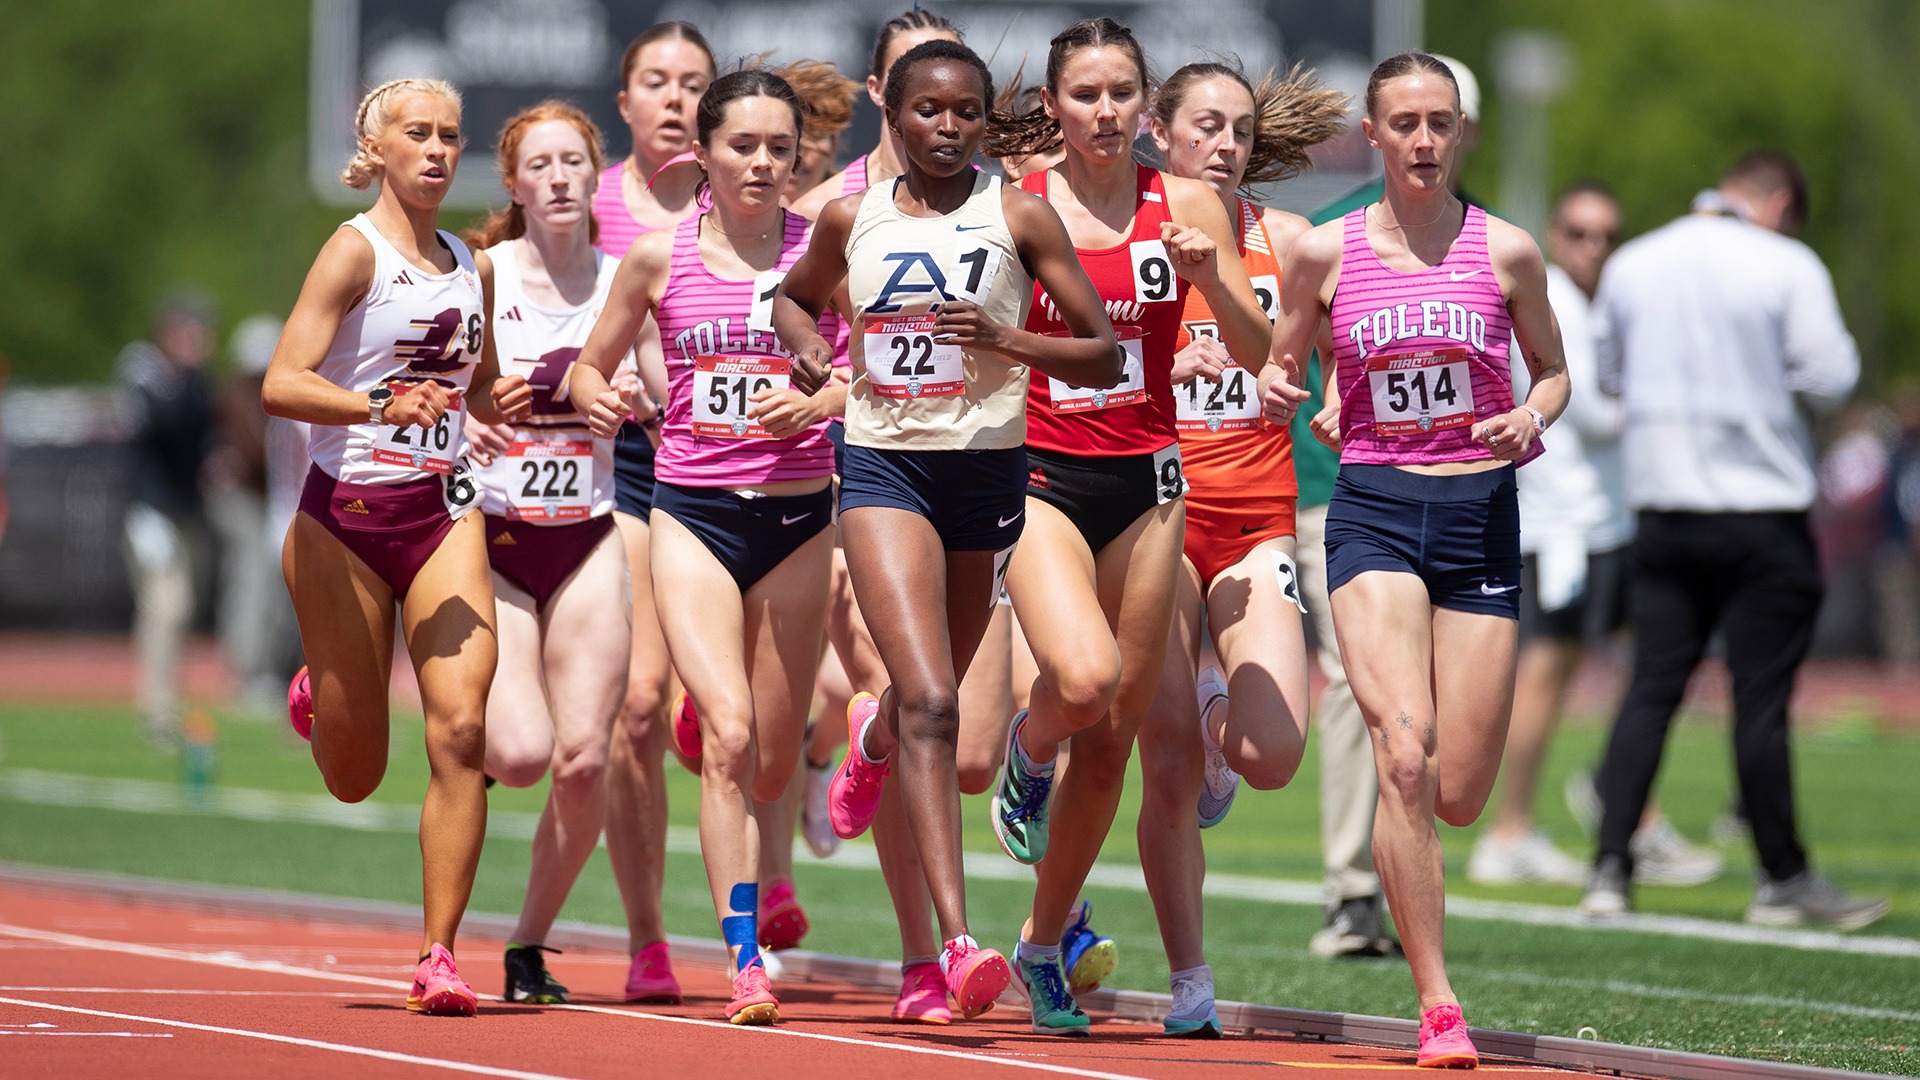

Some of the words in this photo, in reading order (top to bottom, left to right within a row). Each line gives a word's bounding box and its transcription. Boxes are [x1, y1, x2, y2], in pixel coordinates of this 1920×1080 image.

[864, 252, 958, 313] A
[959, 247, 988, 294] 1
[1139, 256, 1170, 300] 9
[467, 313, 482, 355] 6
[675, 315, 797, 366] TOLE
[1349, 300, 1486, 361] TOLEDO
[714, 362, 771, 374] MACTION
[891, 335, 935, 375] 22
[1388, 355, 1447, 369] MACTION
[1183, 371, 1246, 411] 124
[1387, 367, 1456, 413] 514
[521, 460, 579, 497] 222
[1161, 458, 1183, 500] 9
